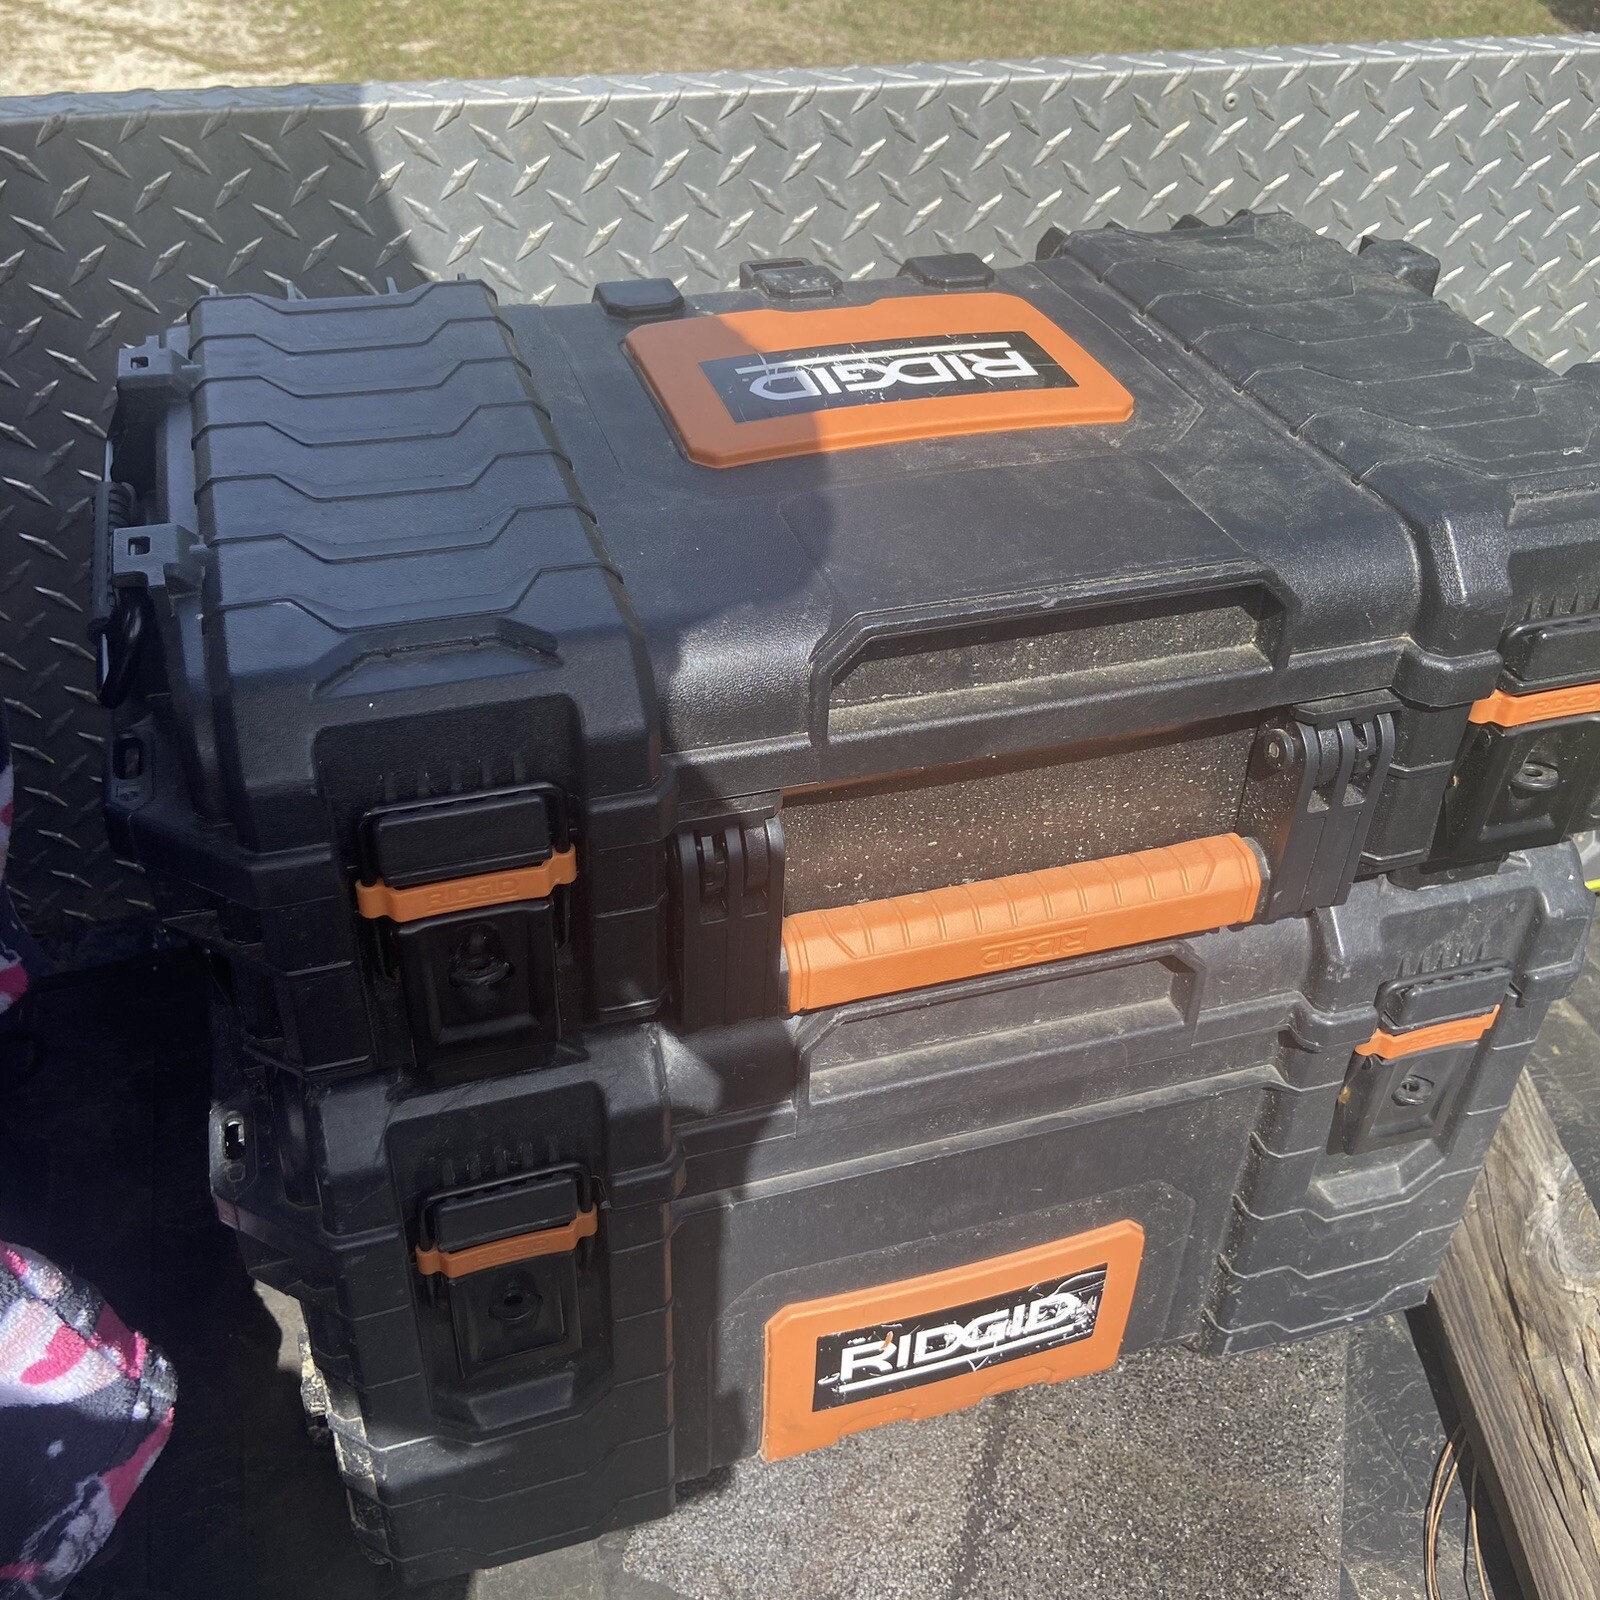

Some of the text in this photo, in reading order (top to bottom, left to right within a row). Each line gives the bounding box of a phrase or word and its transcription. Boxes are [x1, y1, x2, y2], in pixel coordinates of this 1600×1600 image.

[748, 350, 1039, 401] RIDGID
[427, 878, 520, 907] RIDGID
[979, 929, 1088, 968] RIDGID
[840, 1293, 1080, 1382] RIDGID
